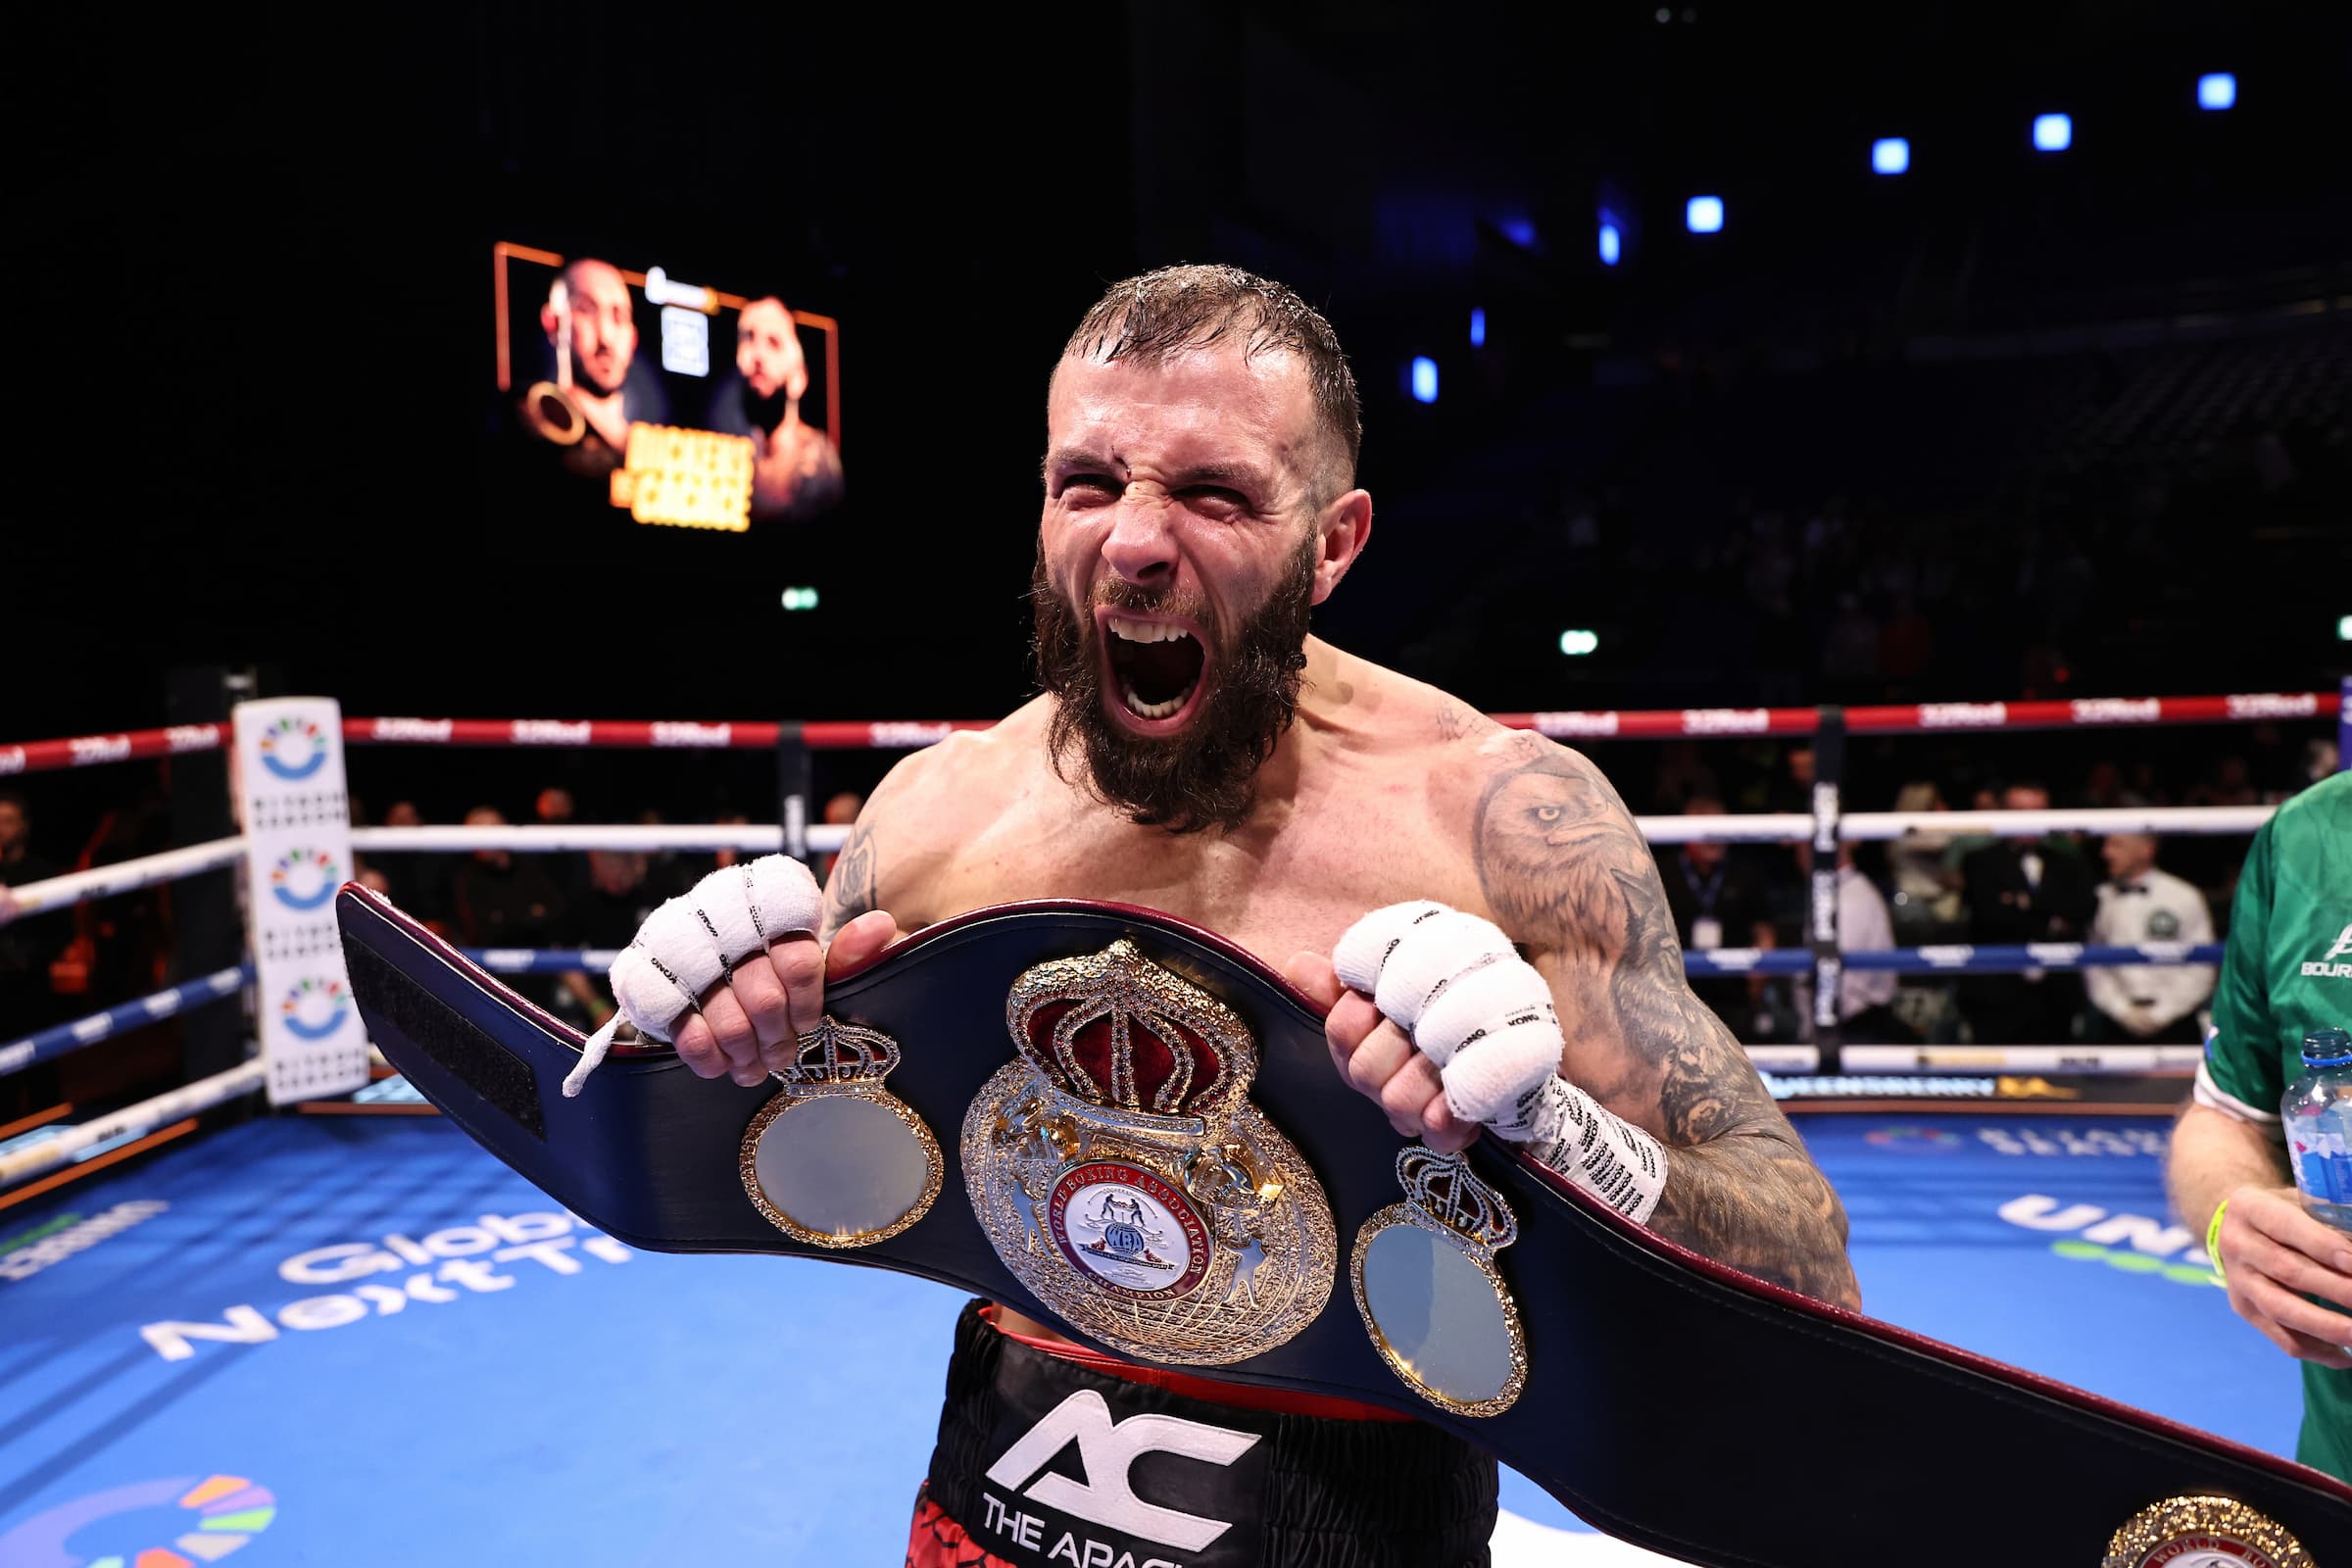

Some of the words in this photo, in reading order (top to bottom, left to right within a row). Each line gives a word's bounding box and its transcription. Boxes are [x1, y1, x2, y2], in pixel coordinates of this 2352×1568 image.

[1683, 709, 1768, 733] 32Red
[1918, 703, 2006, 728] 32Red
[2301, 961, 2352, 978] BOUR
[1507, 1014, 1540, 1027] KONG
[1052, 1188, 1068, 1246] WORLD
[1066, 1165, 1128, 1192] BOXING
[1134, 1174, 1205, 1274] ASSOCIATION
[1108, 1228, 1144, 1251] WBA
[140, 1259, 516, 1361] Next
[985, 1389, 1263, 1553] AC
[983, 1492, 1046, 1552] THE
[1048, 1532, 1183, 1568] APA
[2154, 1537, 2220, 1564] WORLD
